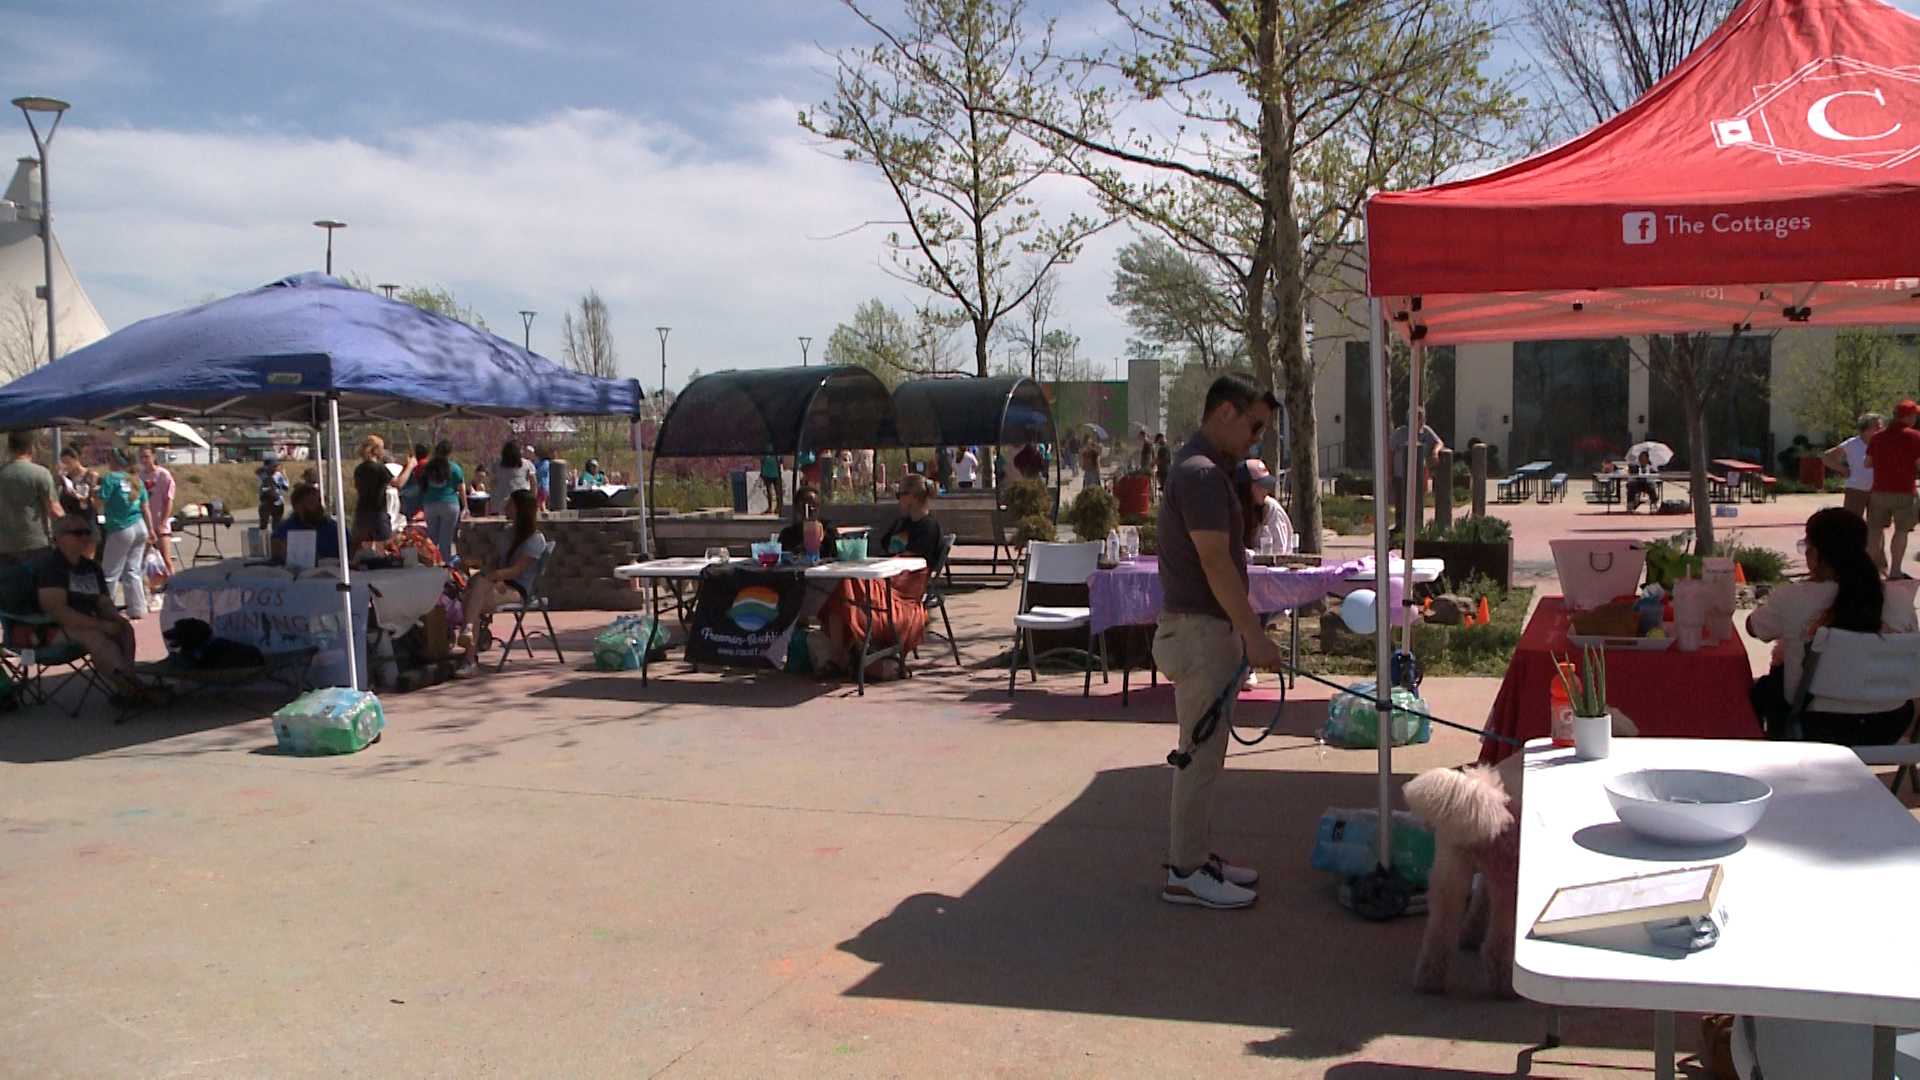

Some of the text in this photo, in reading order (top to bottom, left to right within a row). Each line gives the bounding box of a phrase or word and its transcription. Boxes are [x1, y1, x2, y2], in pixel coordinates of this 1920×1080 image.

[1807, 87, 1901, 140] C
[1665, 214, 1704, 235] The
[1711, 212, 1811, 239] Cottages
